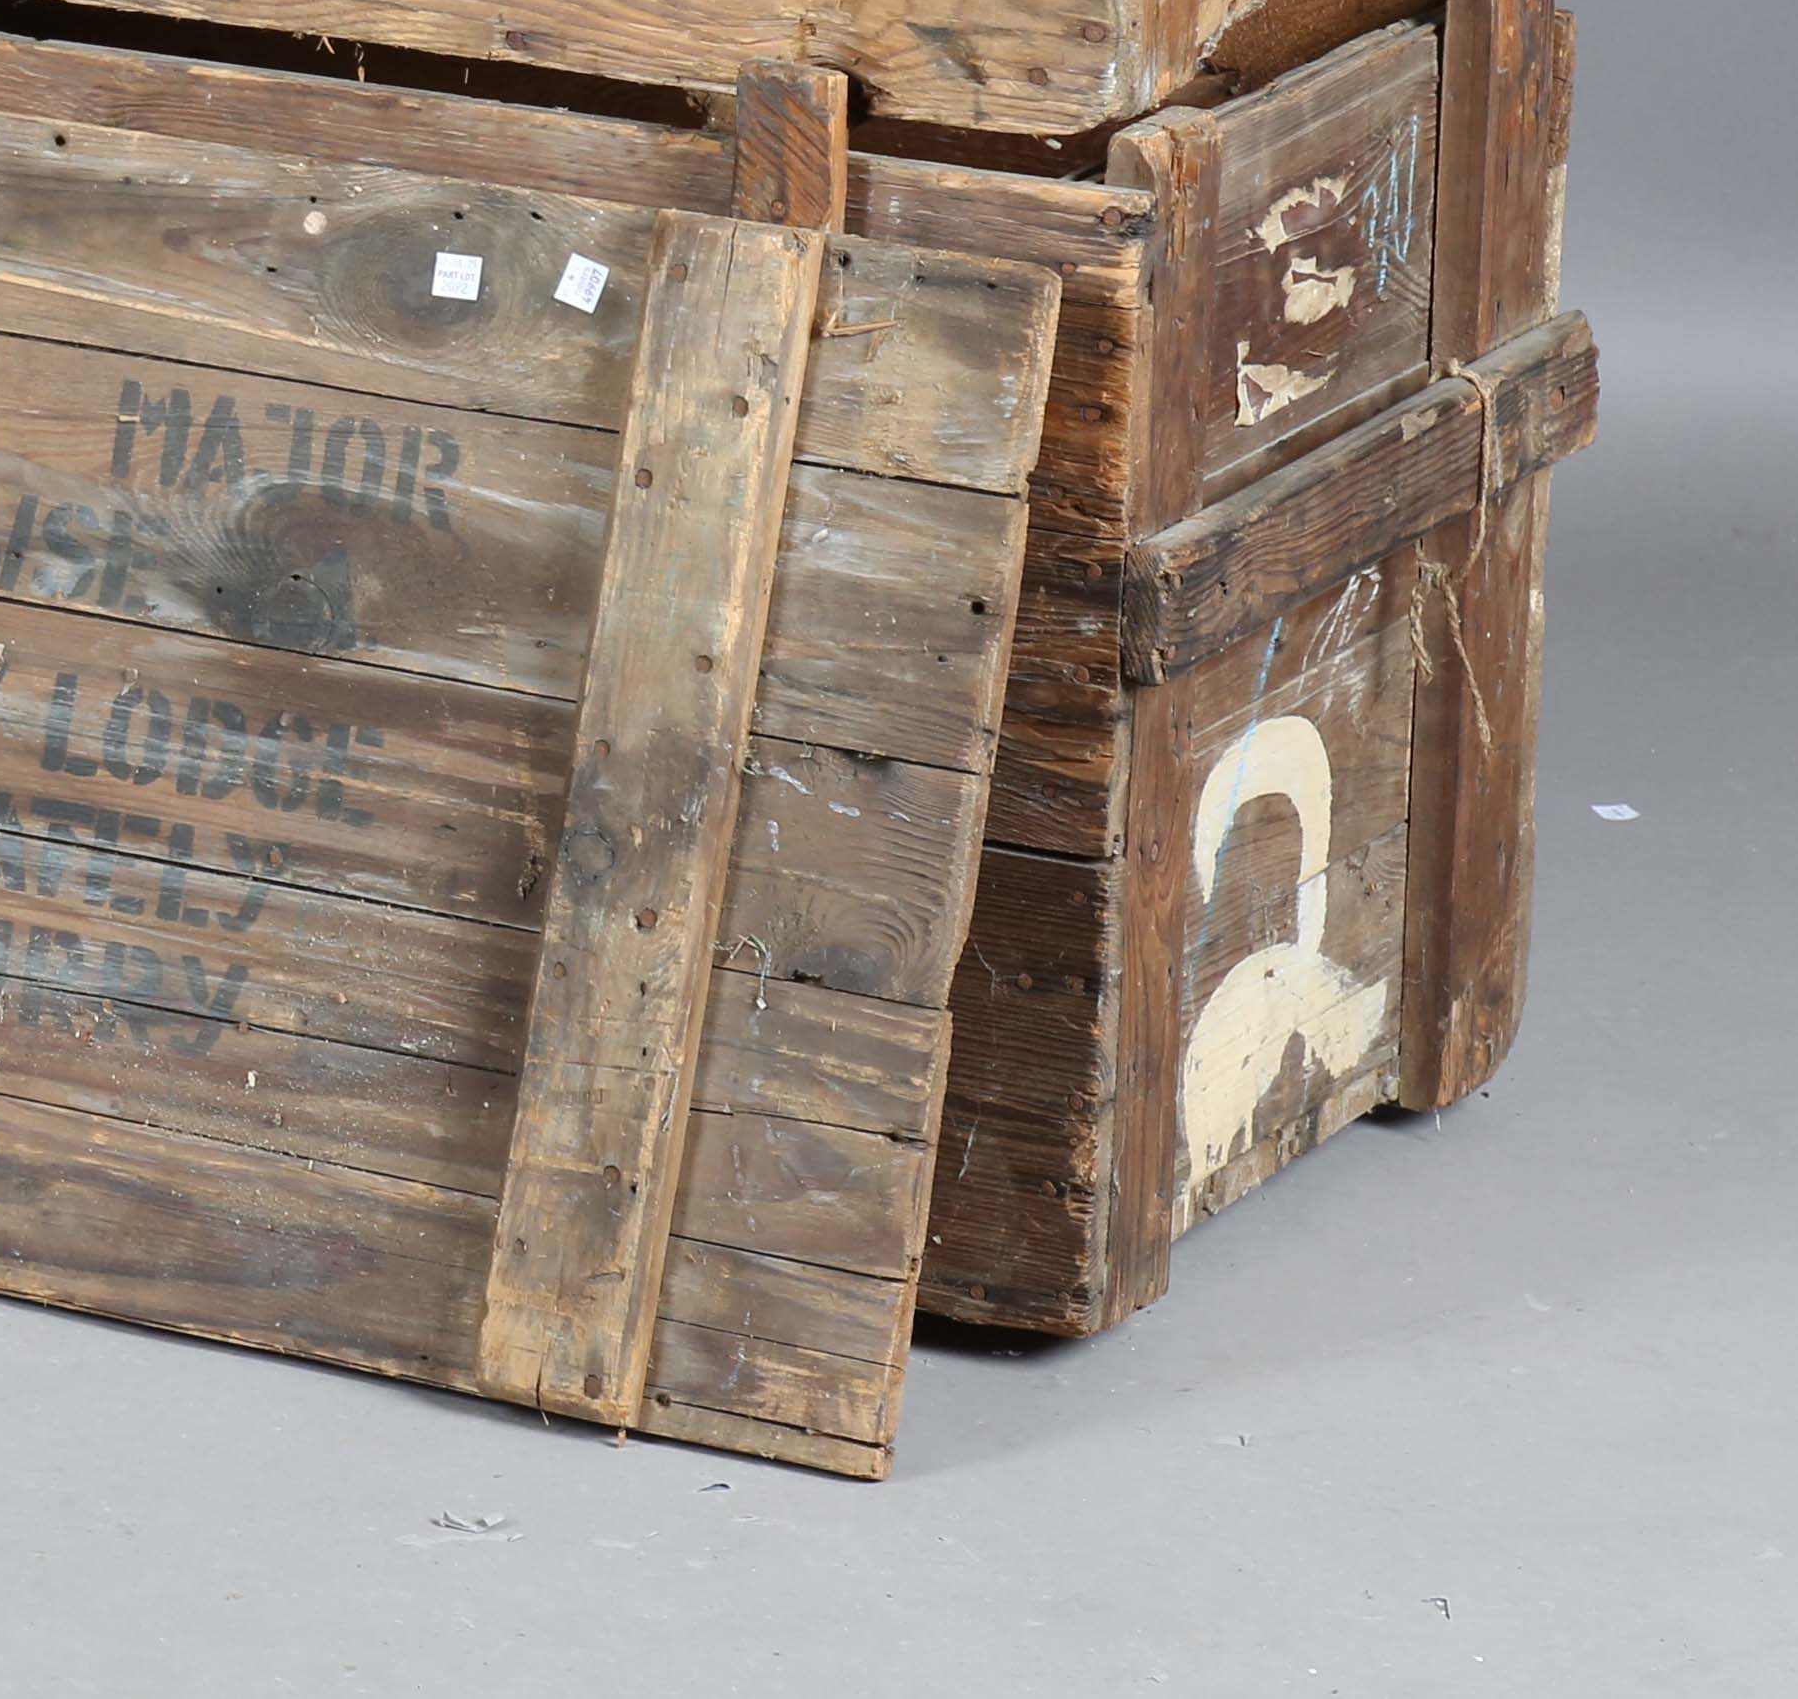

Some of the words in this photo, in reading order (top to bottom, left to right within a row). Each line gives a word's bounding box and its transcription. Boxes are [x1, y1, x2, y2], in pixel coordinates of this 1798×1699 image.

[110, 379, 460, 535] MAJOR
[39, 672, 384, 828] LODGE
[1186, 714, 1389, 1192] 2
